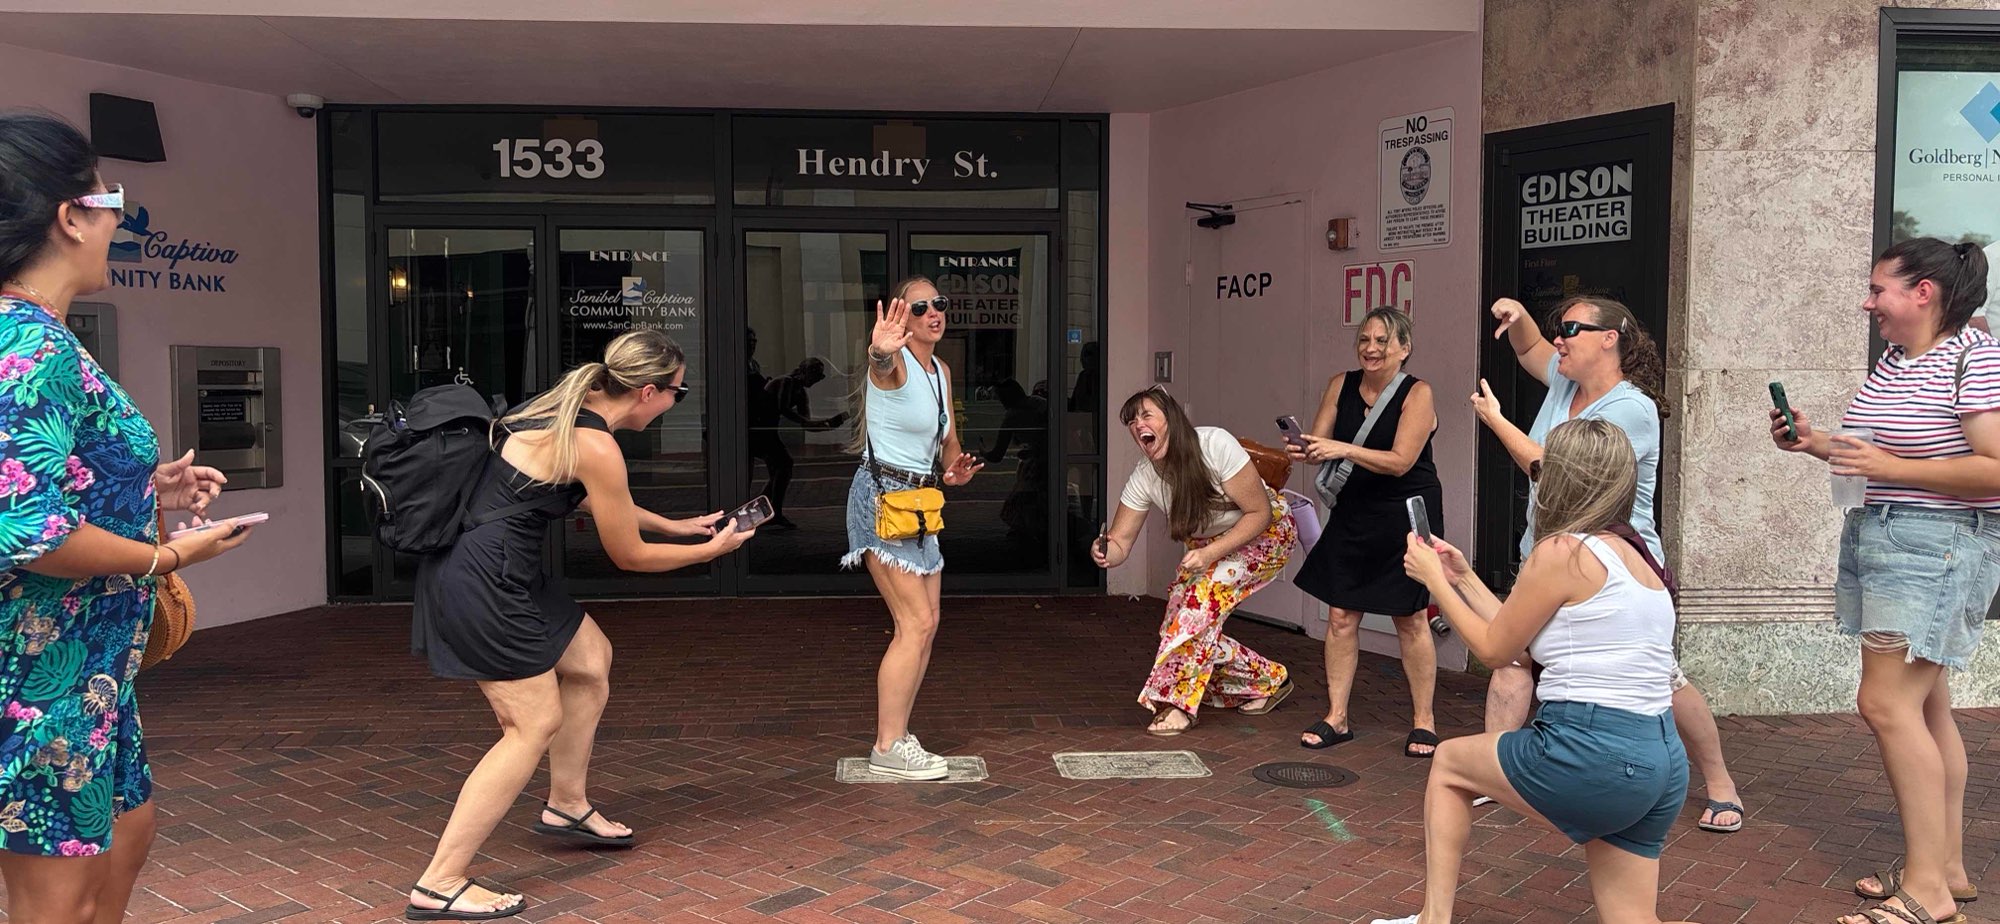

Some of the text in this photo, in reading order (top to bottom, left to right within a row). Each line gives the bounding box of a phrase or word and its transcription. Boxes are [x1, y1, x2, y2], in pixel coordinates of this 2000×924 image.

[1406, 115, 1428, 134] NO
[1385, 130, 1449, 151] TRESPASSING
[492, 138, 605, 179] 1533
[796, 148, 998, 184] Hendry St.
[1522, 162, 1633, 204] EDISON
[1943, 173, 1994, 182] PERSONAL
[1527, 201, 1626, 225] THEATER
[1524, 220, 1628, 244] BUILDING
[144, 231, 240, 269] Captiva
[590, 250, 671, 262] ENTRANCE
[939, 256, 1016, 267] ENTRANCE
[169, 272, 226, 292] BANK
[936, 274, 1023, 294] EDISON
[1216, 272, 1272, 300] FACP
[569, 289, 695, 308] Sanibel Captiva
[1345, 263, 1412, 323] FDC
[570, 305, 696, 317] COMMUNITY BANK
[583, 320, 684, 331] www.SanCapBank.com
